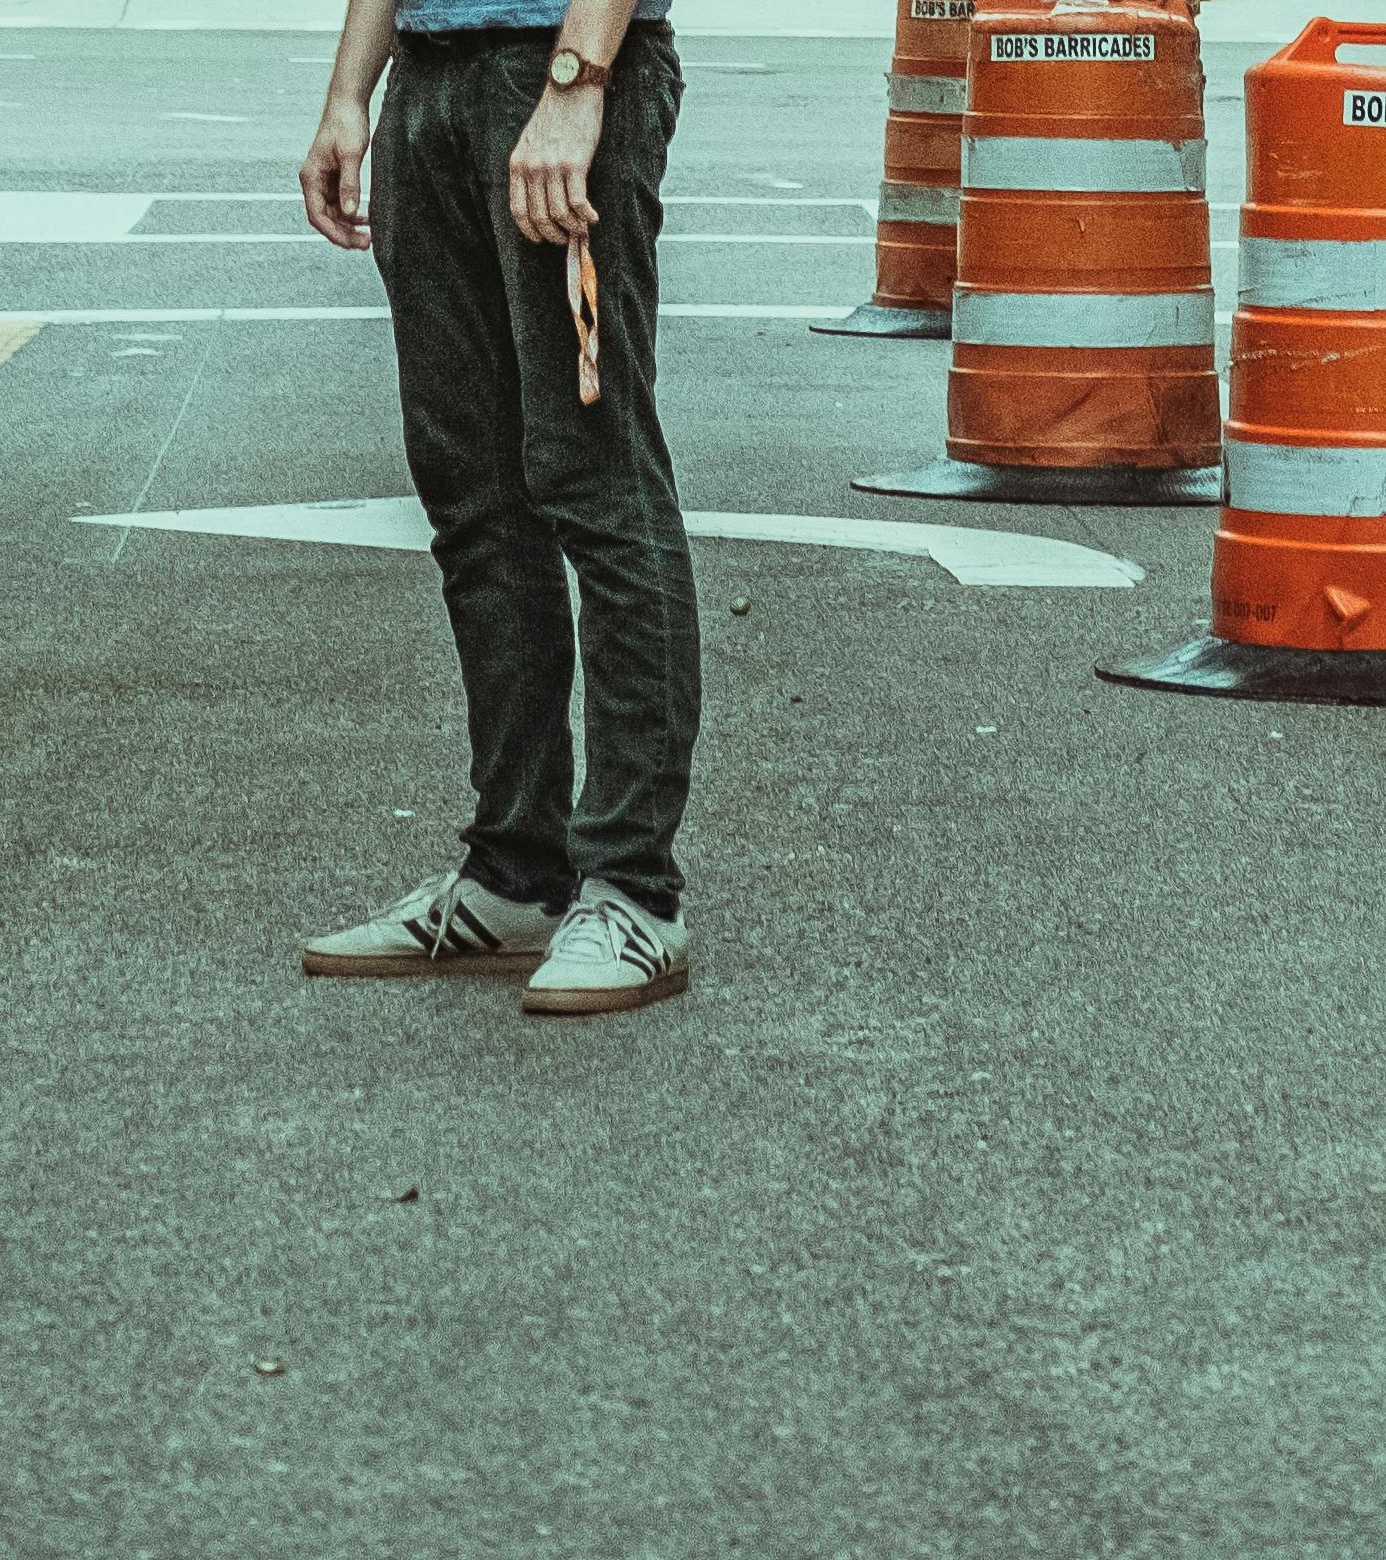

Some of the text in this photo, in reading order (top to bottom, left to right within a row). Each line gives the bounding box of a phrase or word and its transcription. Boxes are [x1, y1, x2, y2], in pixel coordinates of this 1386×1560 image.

[915, 0, 946, 16] BOB'S
[996, 37, 1151, 58] BOB'S BARRICADES
